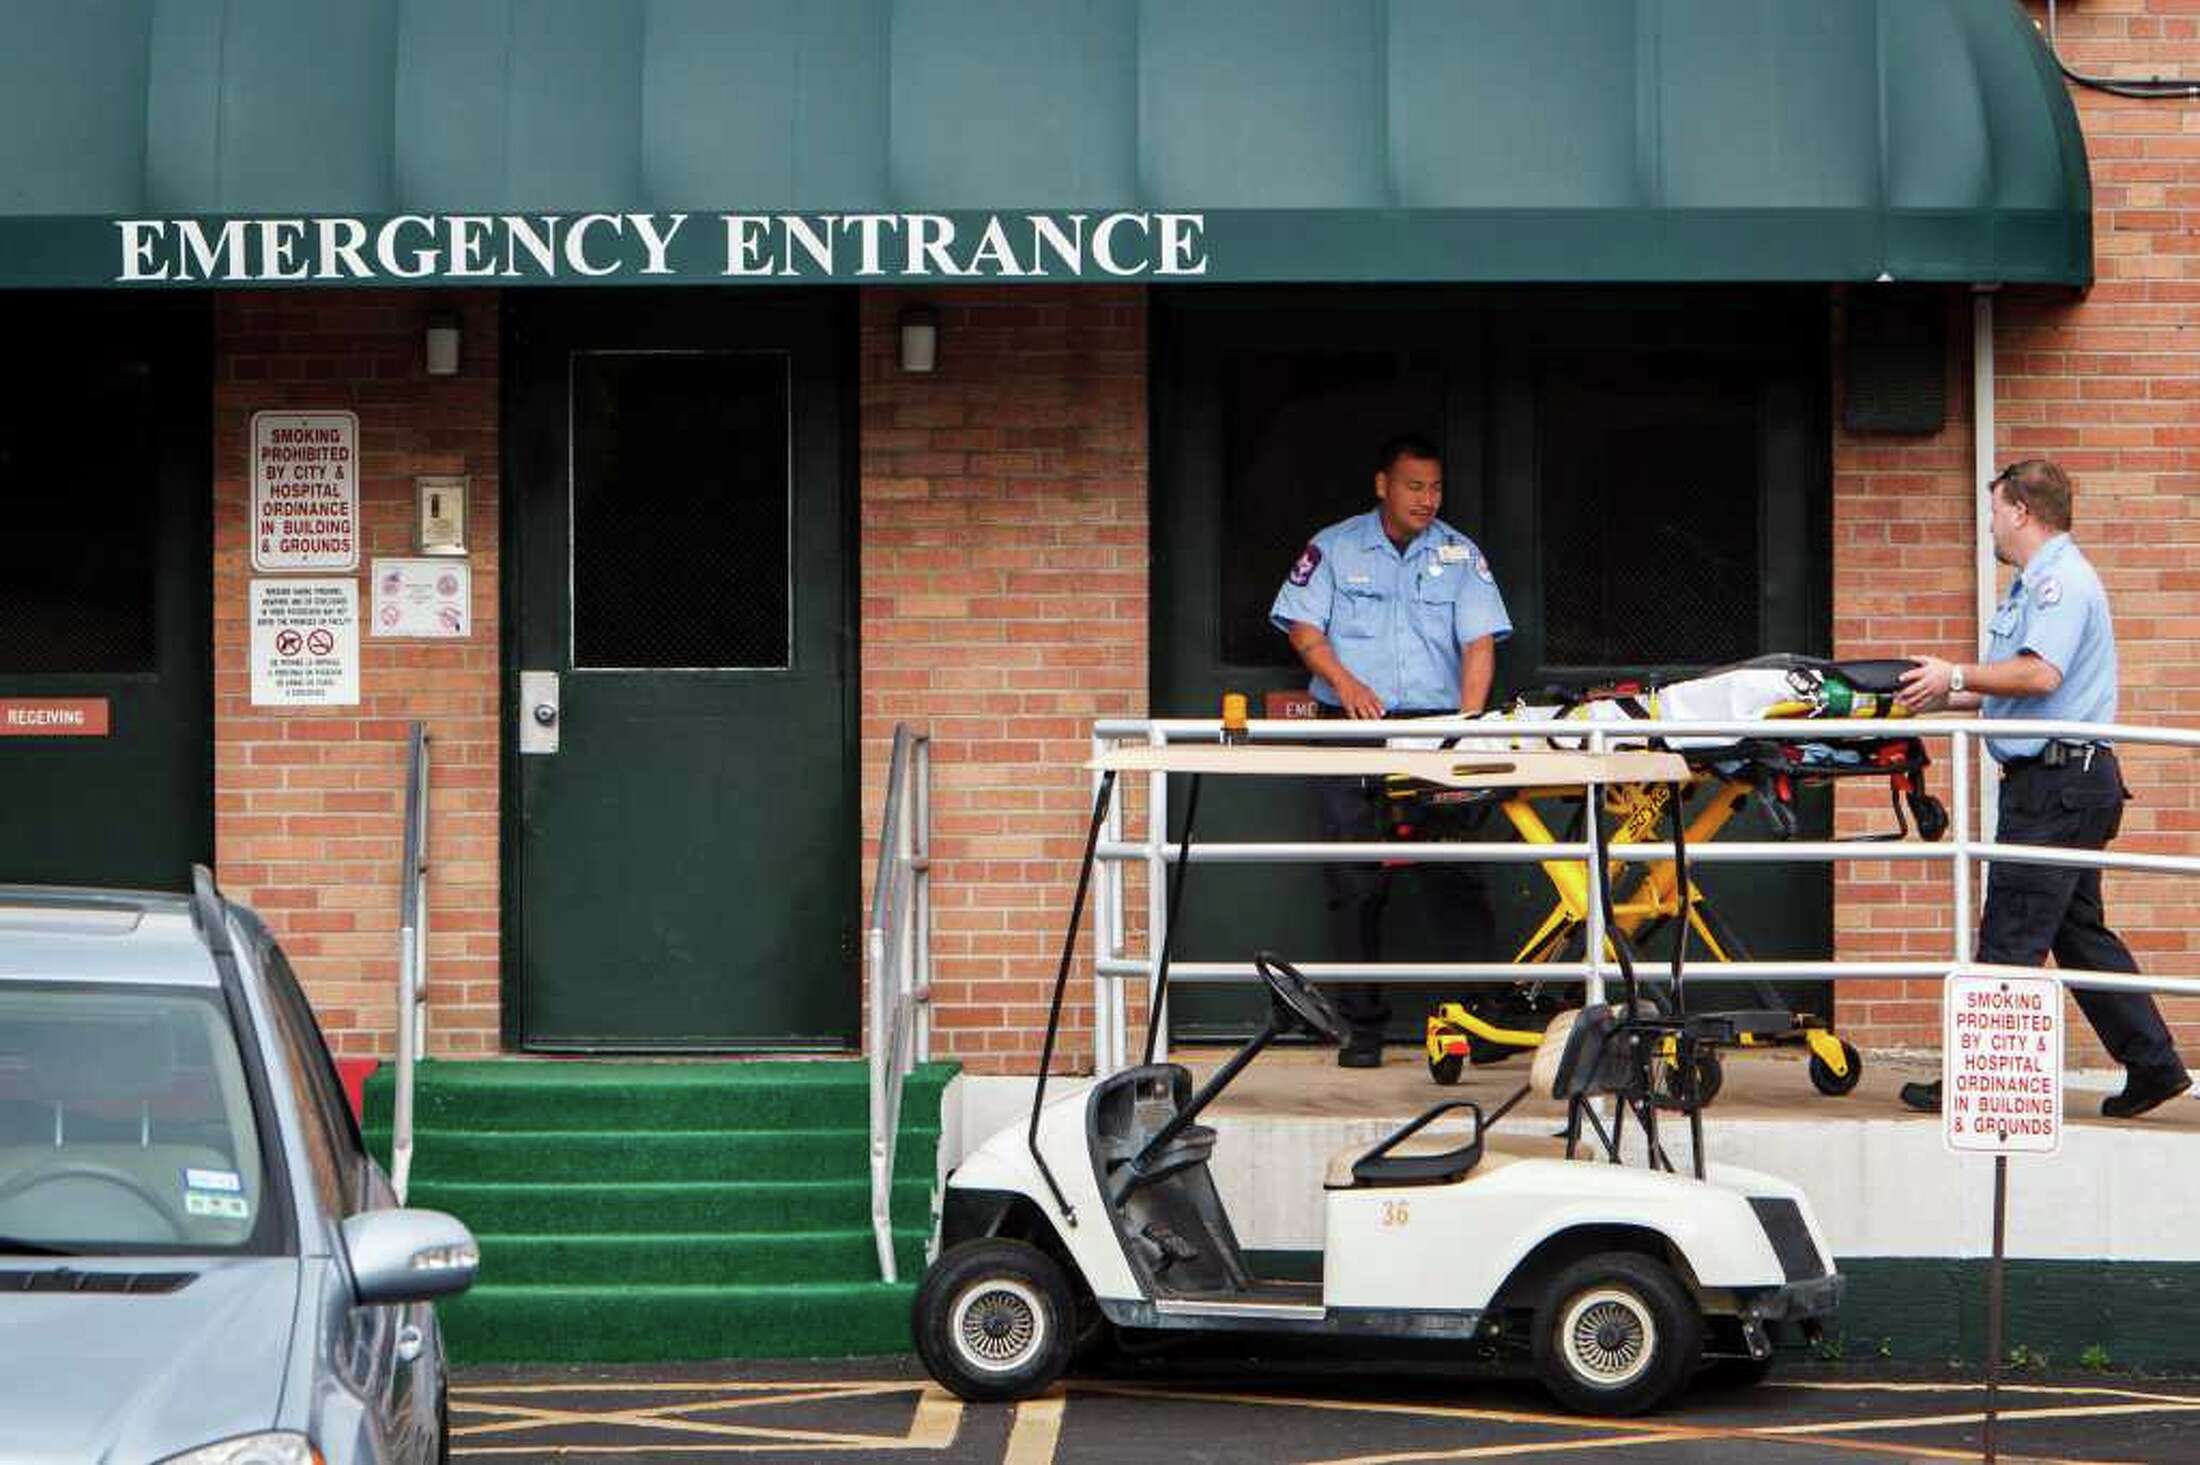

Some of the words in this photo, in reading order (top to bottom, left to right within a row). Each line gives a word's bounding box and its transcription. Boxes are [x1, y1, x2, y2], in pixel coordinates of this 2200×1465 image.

[115, 213, 688, 282] EMERGENCY
[721, 212, 1207, 277] ENTRANCE
[272, 429, 340, 443] SMOKING
[261, 447, 350, 461] PROHIBITED
[266, 466, 284, 480] BY
[294, 466, 327, 480] CITY
[335, 465, 344, 480] &
[270, 484, 341, 498] HOSPITAL
[263, 502, 349, 516] ORDINANCE
[261, 520, 274, 534] IN
[283, 520, 351, 534] BUILDING
[261, 538, 270, 553] &
[280, 538, 351, 553] GROUNDS
[7, 708, 85, 725] RECEIVING
[1967, 993, 2042, 1010] SMOKING
[1957, 1013, 2052, 1031] PROHIBITED
[1961, 1033, 1982, 1049] BY
[1991, 1035, 2027, 1050] CITY
[2036, 1036, 2047, 1051] &
[1965, 1055, 2043, 1072] HOSPITAL
[1956, 1075, 2052, 1093] ORDINANCE
[1955, 1096, 1969, 1112] IN
[1979, 1097, 2052, 1113] BUILDING
[1954, 1117, 1964, 1133] &
[1974, 1118, 2053, 1135] GROUNDS
[1382, 1200, 1409, 1226] 36
